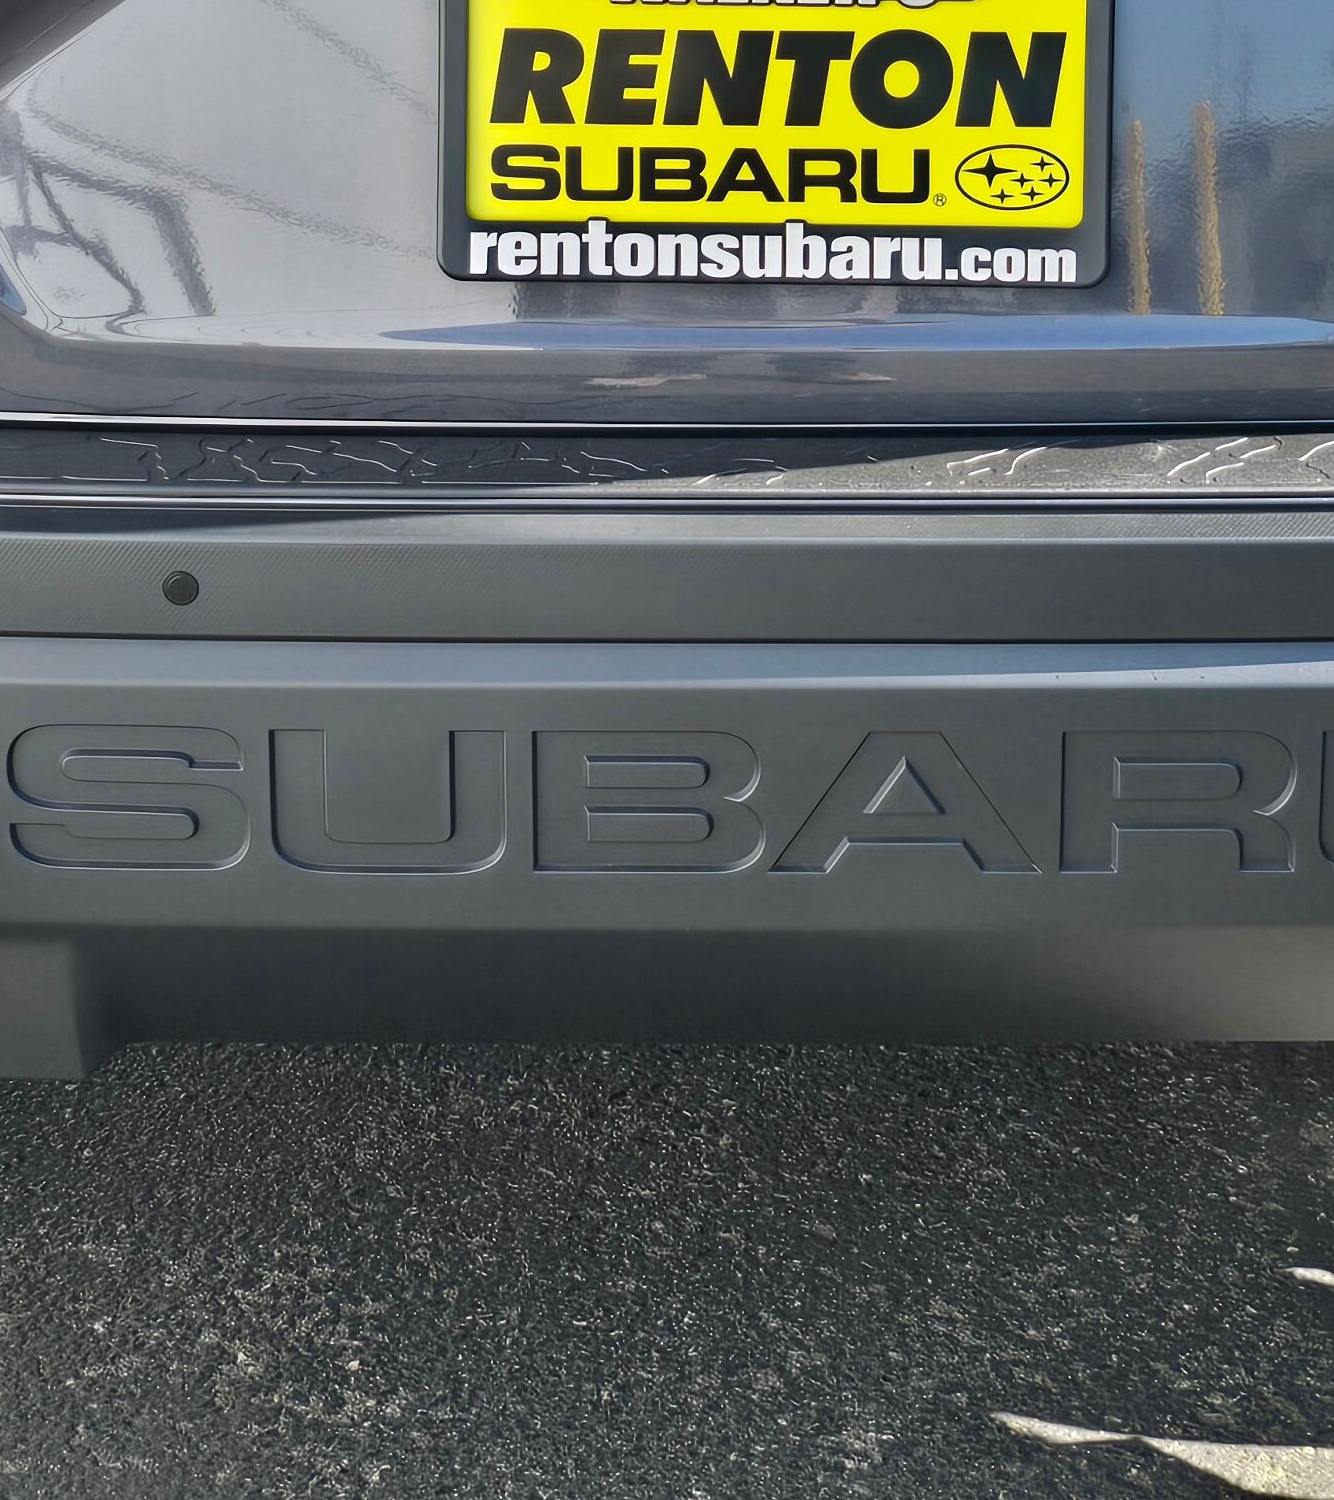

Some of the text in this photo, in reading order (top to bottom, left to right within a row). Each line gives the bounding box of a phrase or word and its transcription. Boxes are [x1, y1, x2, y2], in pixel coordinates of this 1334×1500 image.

[489, 27, 1067, 130] RENTON
[490, 143, 930, 204] SUBARU
[467, 219, 1078, 284] rentonsubaru.com
